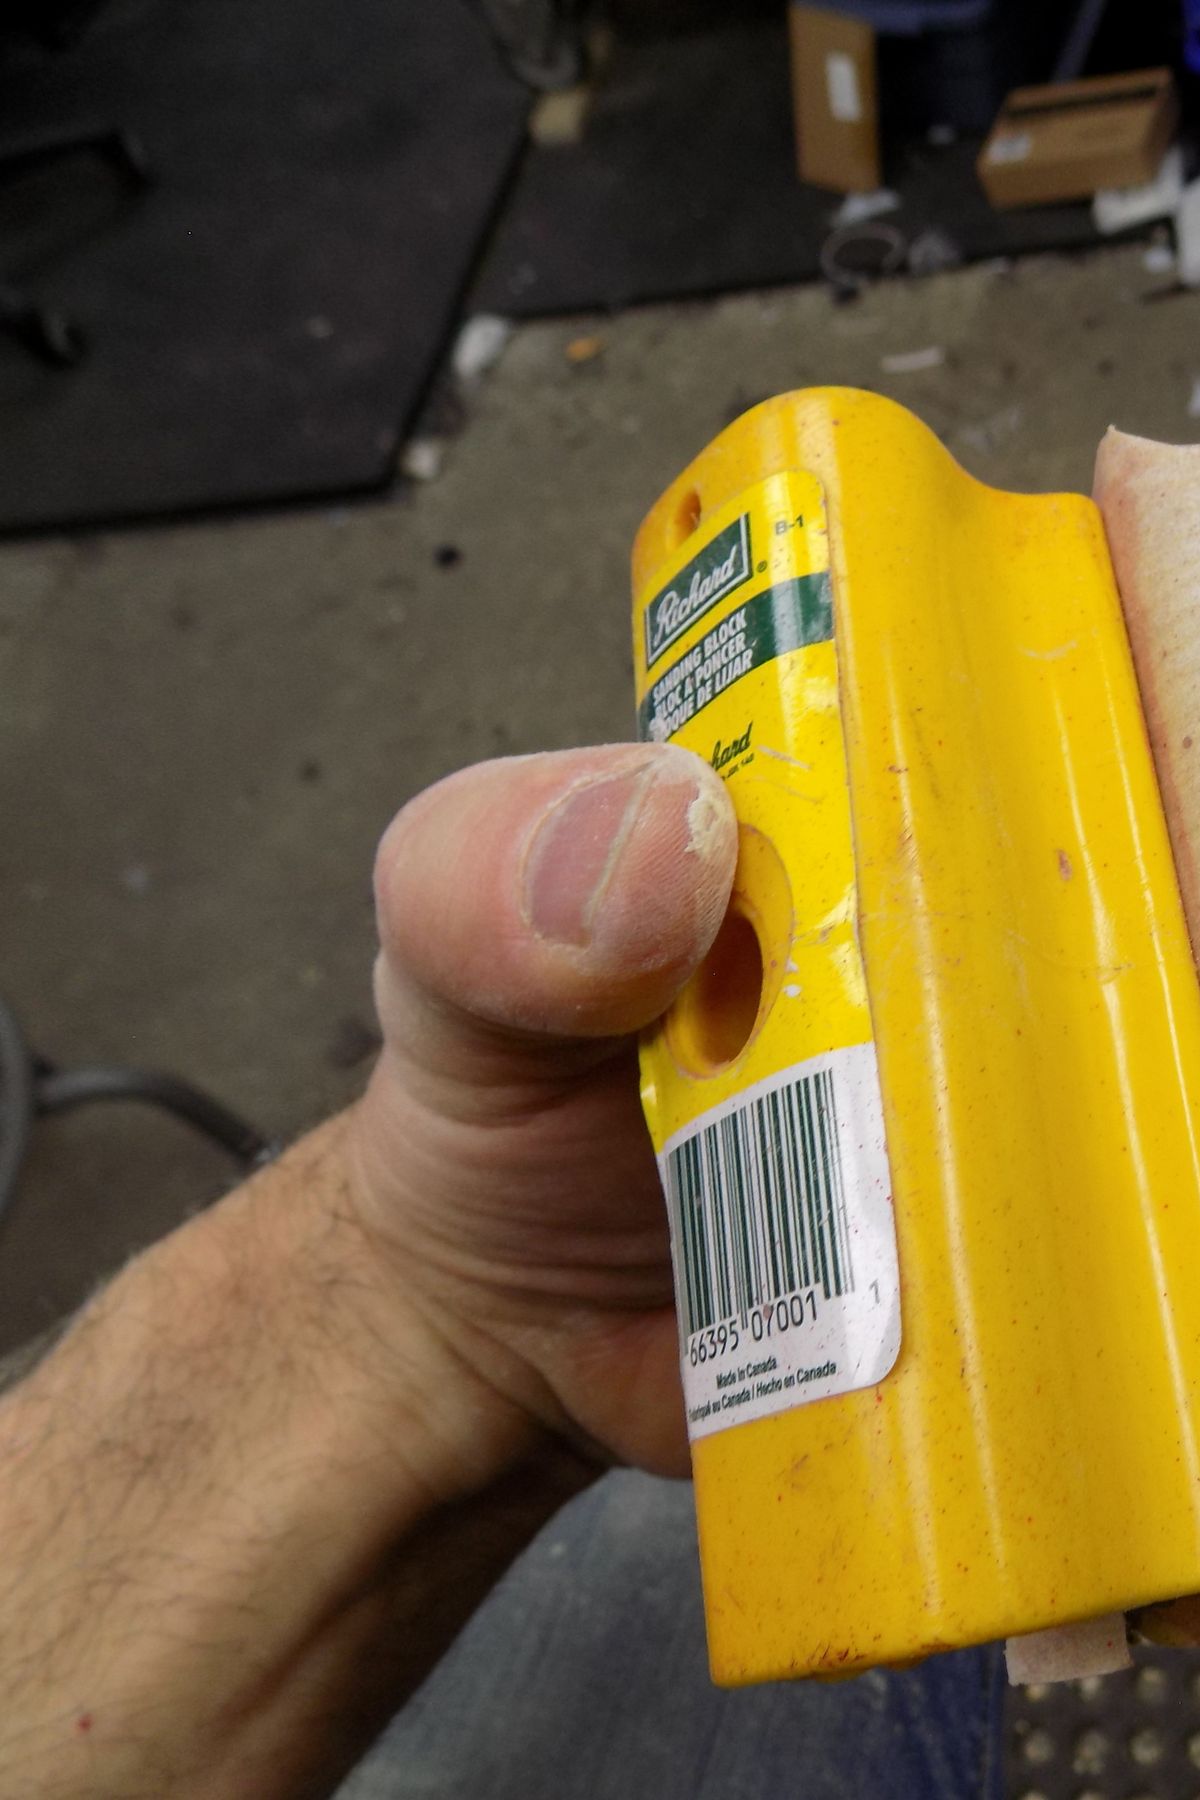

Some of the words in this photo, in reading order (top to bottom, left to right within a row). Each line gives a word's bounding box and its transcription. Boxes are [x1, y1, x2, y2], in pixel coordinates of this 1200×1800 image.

[775, 514, 804, 535] B-1
[653, 544, 738, 648] Richard
[653, 646, 701, 706] SANDING
[704, 607, 747, 658] BLOCK
[695, 631, 746, 687] PONCER
[697, 679, 713, 710] DE
[690, 1319, 739, 1367] 66395
[751, 1290, 817, 1342] 07001
[722, 1388, 751, 1409] Canada
[797, 1360, 837, 1384] Canada
[746, 1356, 777, 1378] Canada
